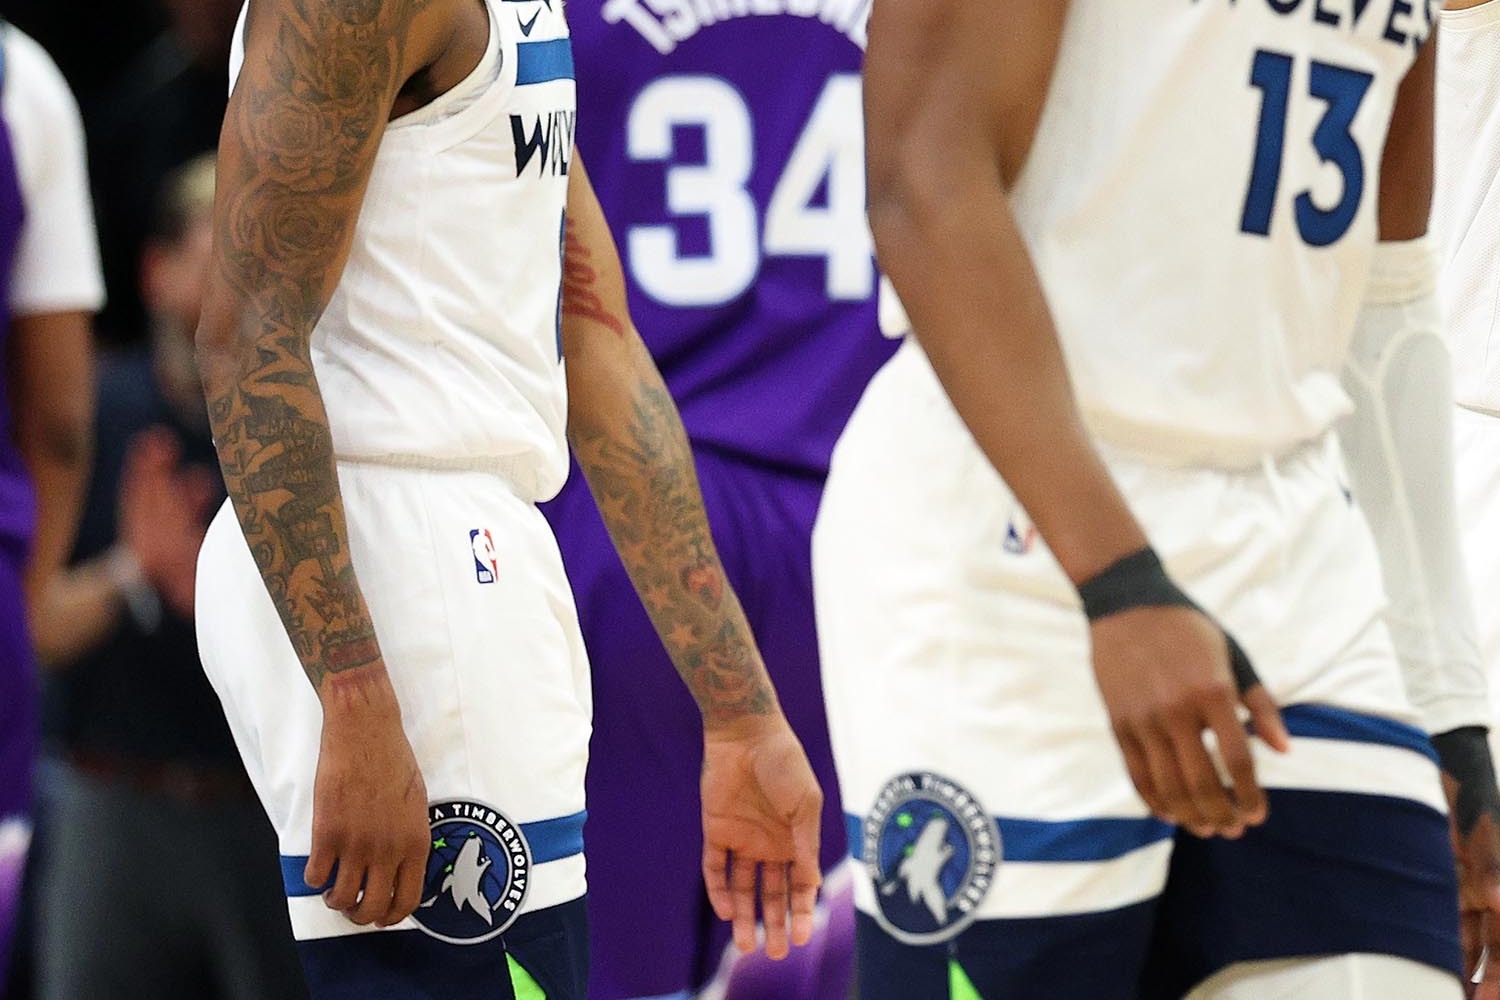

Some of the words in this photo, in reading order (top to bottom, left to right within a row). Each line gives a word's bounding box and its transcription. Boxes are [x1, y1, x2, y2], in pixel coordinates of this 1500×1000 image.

[626, 73, 873, 308] 34
[1239, 48, 1375, 249] 13
[451, 803, 527, 912] TIMBERWOLVES
